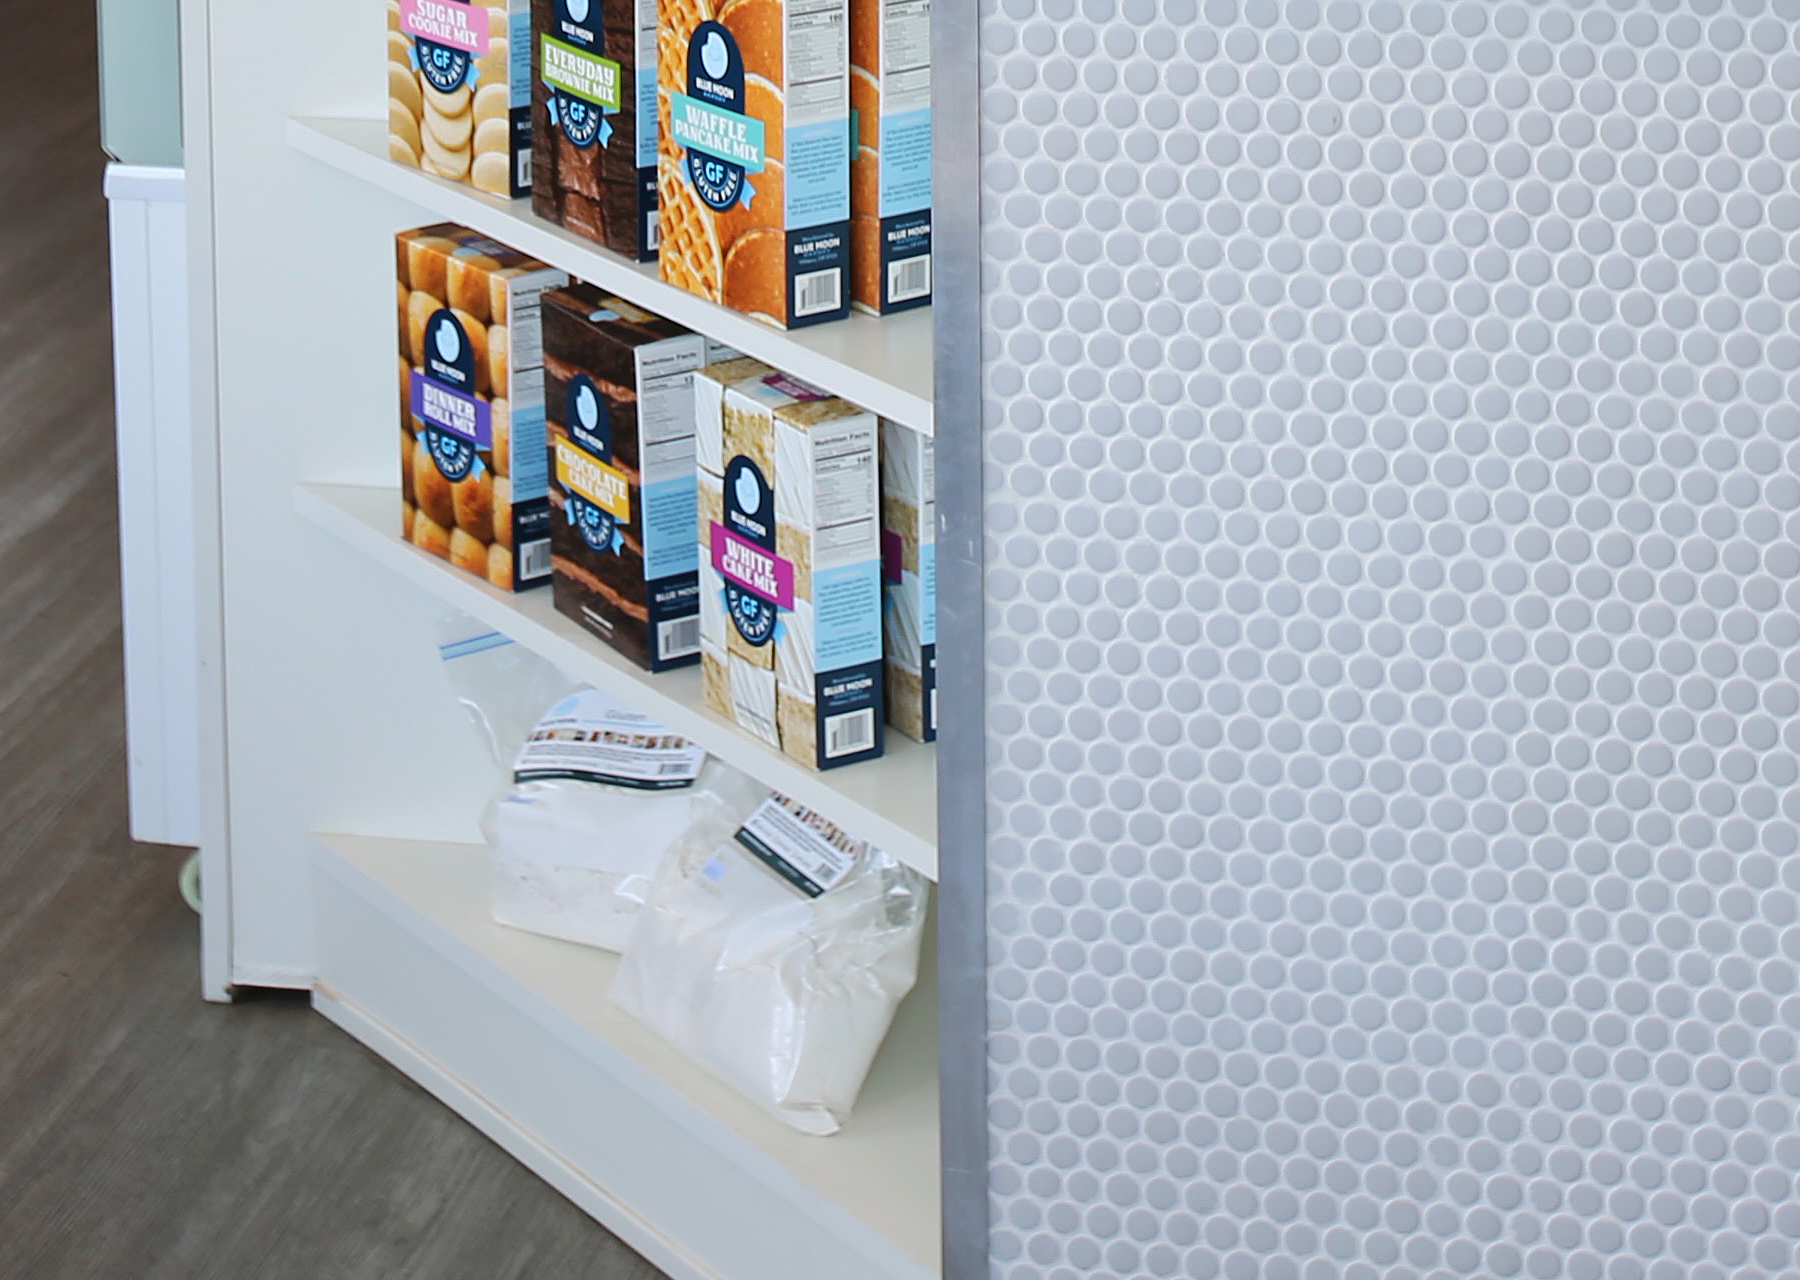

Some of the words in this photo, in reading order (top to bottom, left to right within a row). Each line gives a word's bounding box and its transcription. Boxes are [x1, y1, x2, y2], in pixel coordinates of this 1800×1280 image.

[408, 13, 453, 41] COOKIE
[453, 27, 478, 48] MIX
[561, 20, 575, 36] BLUE
[575, 25, 594, 43] MOON
[432, 48, 451, 69] GF
[544, 43, 615, 87] EVERYDAY
[544, 61, 592, 96] BROWNIE
[592, 82, 615, 105] MIX
[695, 77, 713, 91] BLUE
[713, 81, 735, 100] MOON
[569, 101, 586, 122] GF
[685, 104, 747, 142] WAFFLE
[517, 120, 532, 130] BLU
[674, 118, 732, 154] PANCAKE
[731, 141, 759, 164] MIX
[693, 158, 720, 202] GLUTEN
[720, 171, 738, 201] FREE
[705, 161, 725, 184] GF
[793, 241, 815, 255] BLUE
[815, 237, 841, 250] MOON
[887, 229, 907, 242] BLUE
[642, 355, 676, 367] Nutrition
[676, 351, 698, 361] Facts
[422, 382, 476, 422] DINNER
[422, 400, 453, 428] ROLL
[451, 414, 477, 438] MIX
[440, 436, 458, 457] GF
[814, 436, 848, 446] Nutrition
[848, 431, 870, 440] Facts
[556, 443, 628, 501] CHOCOLATE
[568, 468, 597, 496] CAKE
[595, 485, 616, 509] MIX
[519, 513, 538, 525] BLUE
[584, 505, 600, 528] GF
[730, 509, 746, 527] BLUE
[746, 517, 767, 538] MOON
[724, 536, 776, 579] WHITE
[721, 553, 754, 585] CAKE
[752, 571, 779, 598] MIX
[655, 591, 677, 603] BLUE
[741, 595, 758, 618] GF
[823, 683, 845, 697] BLUE
[846, 677, 873, 691] MOON
